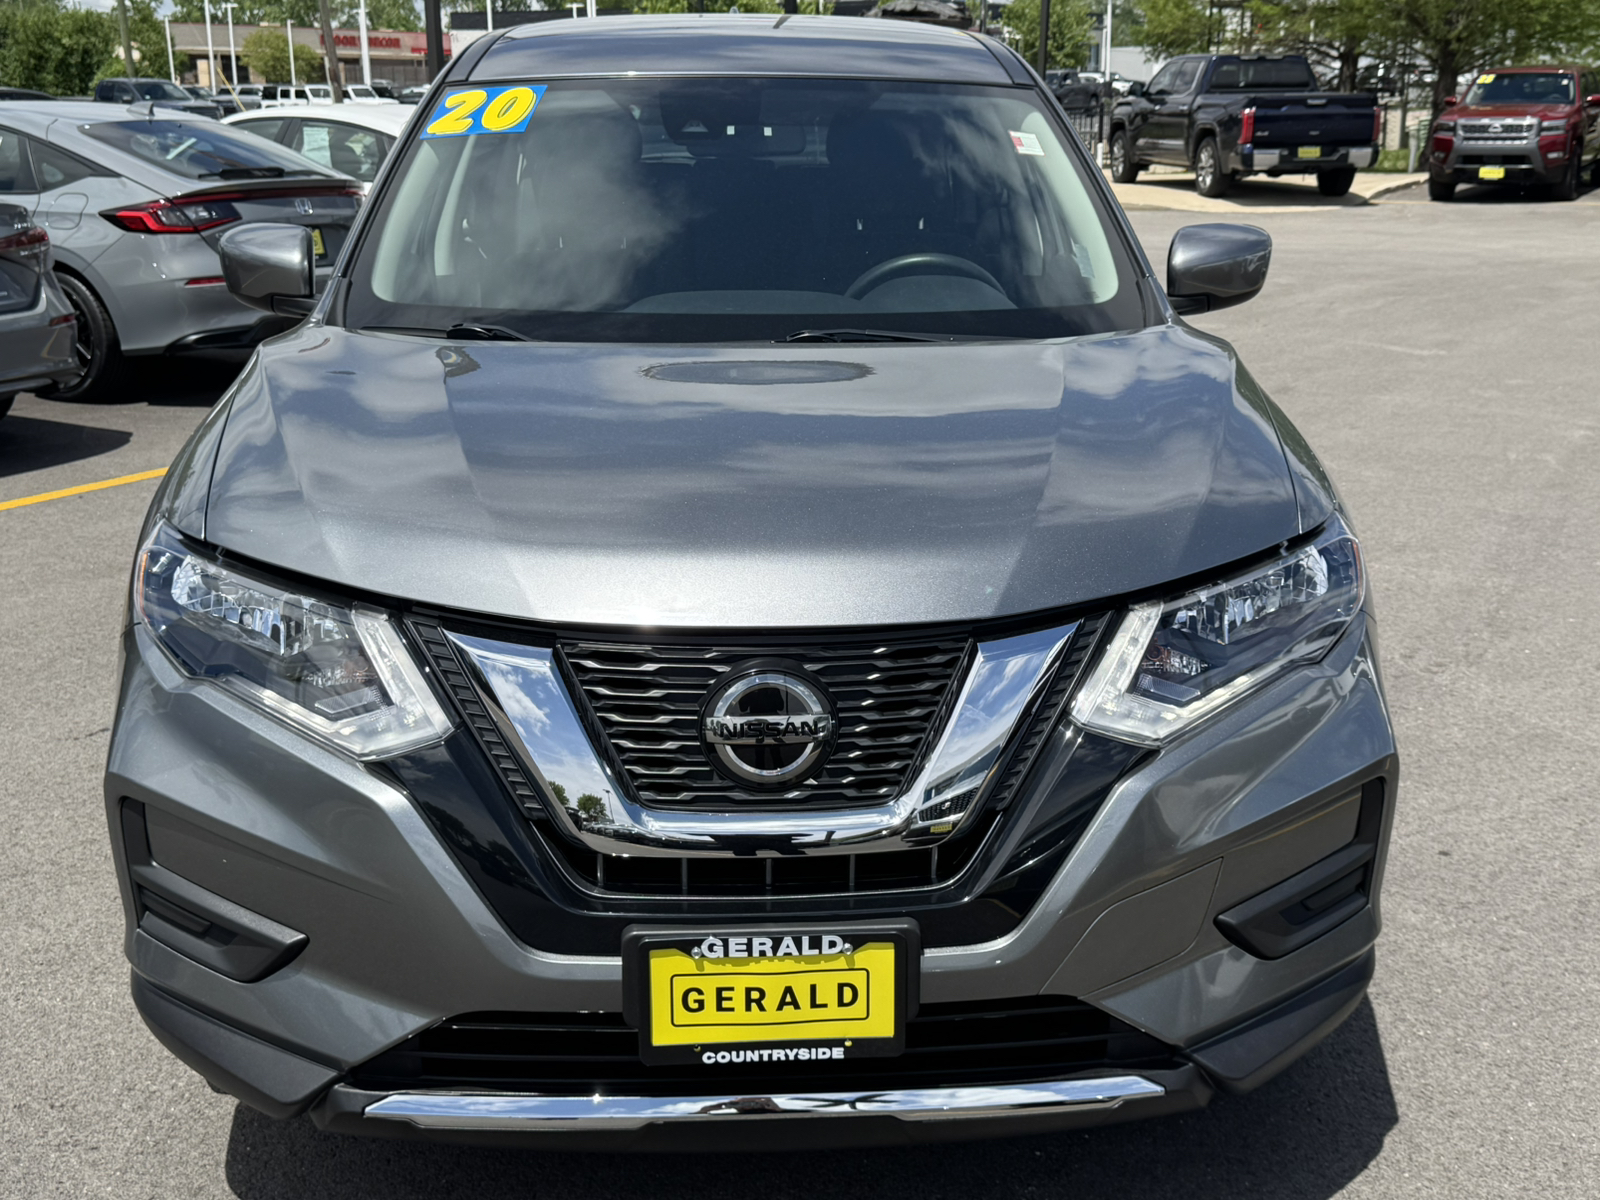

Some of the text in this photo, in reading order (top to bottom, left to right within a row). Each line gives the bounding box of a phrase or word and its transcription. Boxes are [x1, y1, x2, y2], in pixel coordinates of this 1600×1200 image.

[320, 34, 358, 47] FOOR
[427, 87, 536, 134] 20
[720, 720, 818, 738] NISSAN
[701, 935, 844, 958] GERALD
[681, 982, 859, 1013] GERALD
[702, 1047, 845, 1064] COUNTRYSIDE
